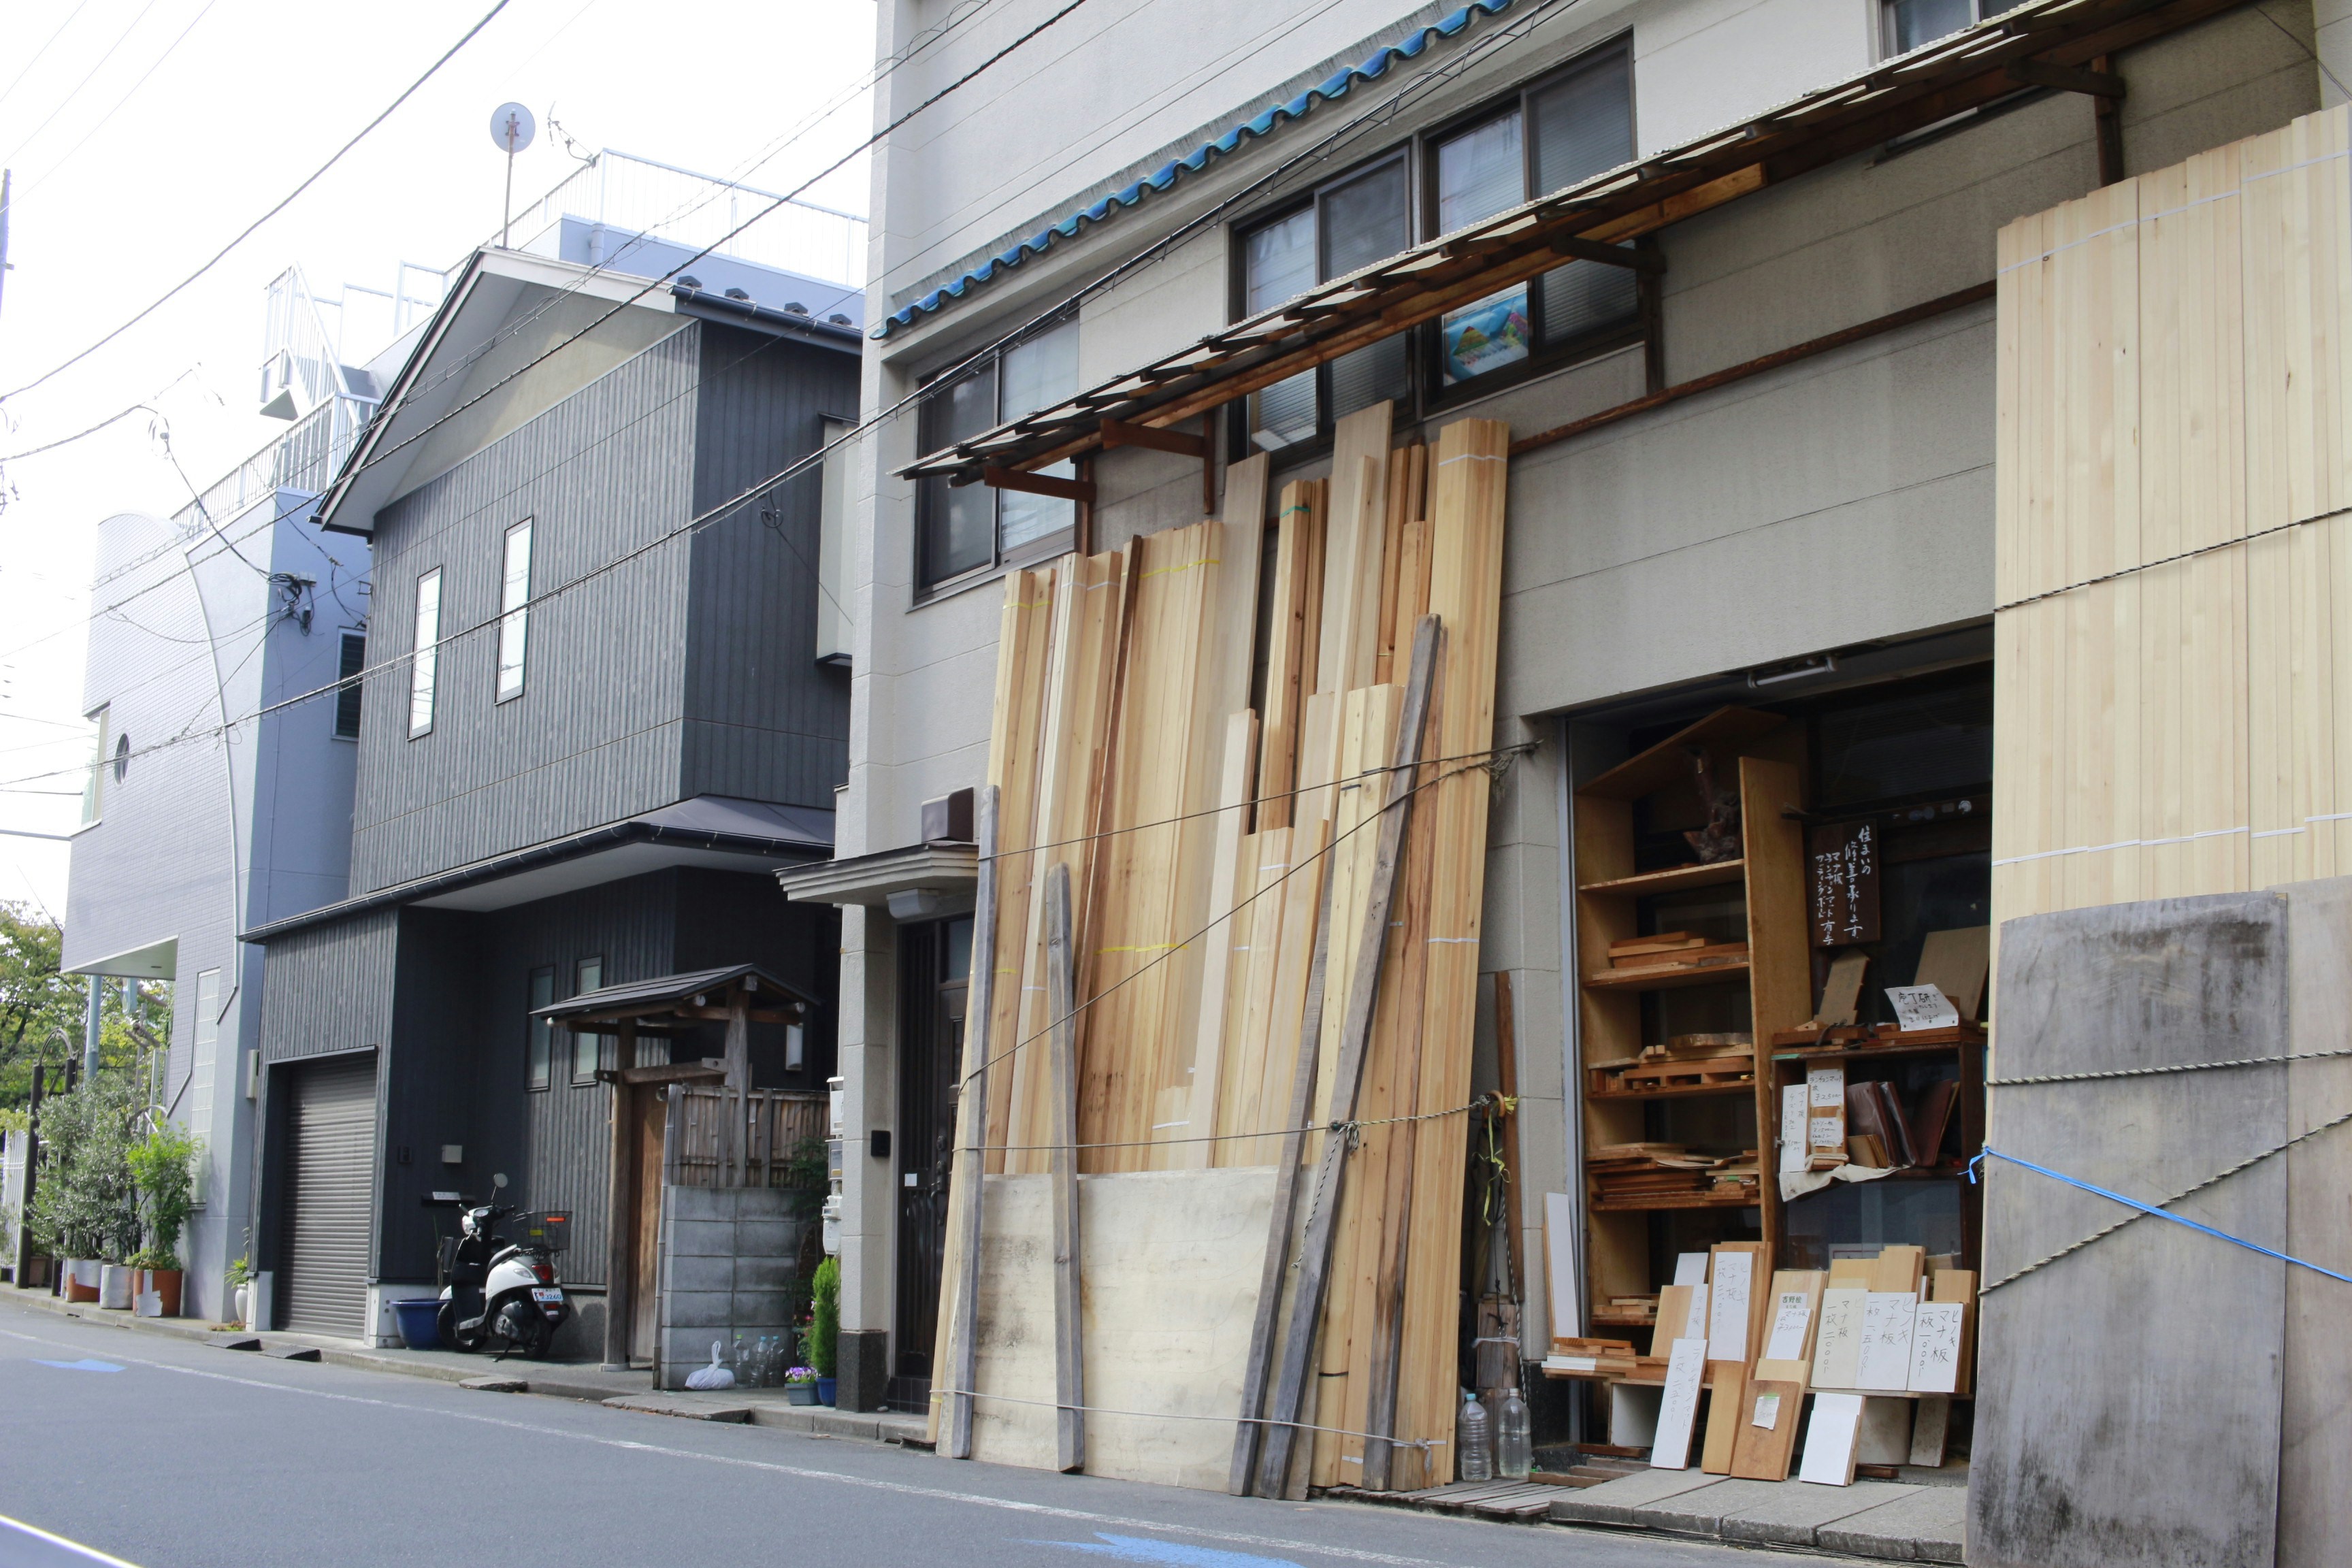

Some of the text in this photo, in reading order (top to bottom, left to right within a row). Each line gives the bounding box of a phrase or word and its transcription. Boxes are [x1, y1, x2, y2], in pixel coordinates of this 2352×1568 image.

[1831, 852, 1843, 885] マナ板
[1858, 825, 1872, 875] 住まいの
[1880, 1299, 1899, 1345] マナ板
[1897, 1296, 1915, 1344] ヒノキ
[1931, 1310, 1950, 1363] マナ板
[1949, 1309, 1959, 1348] ヒノキ
